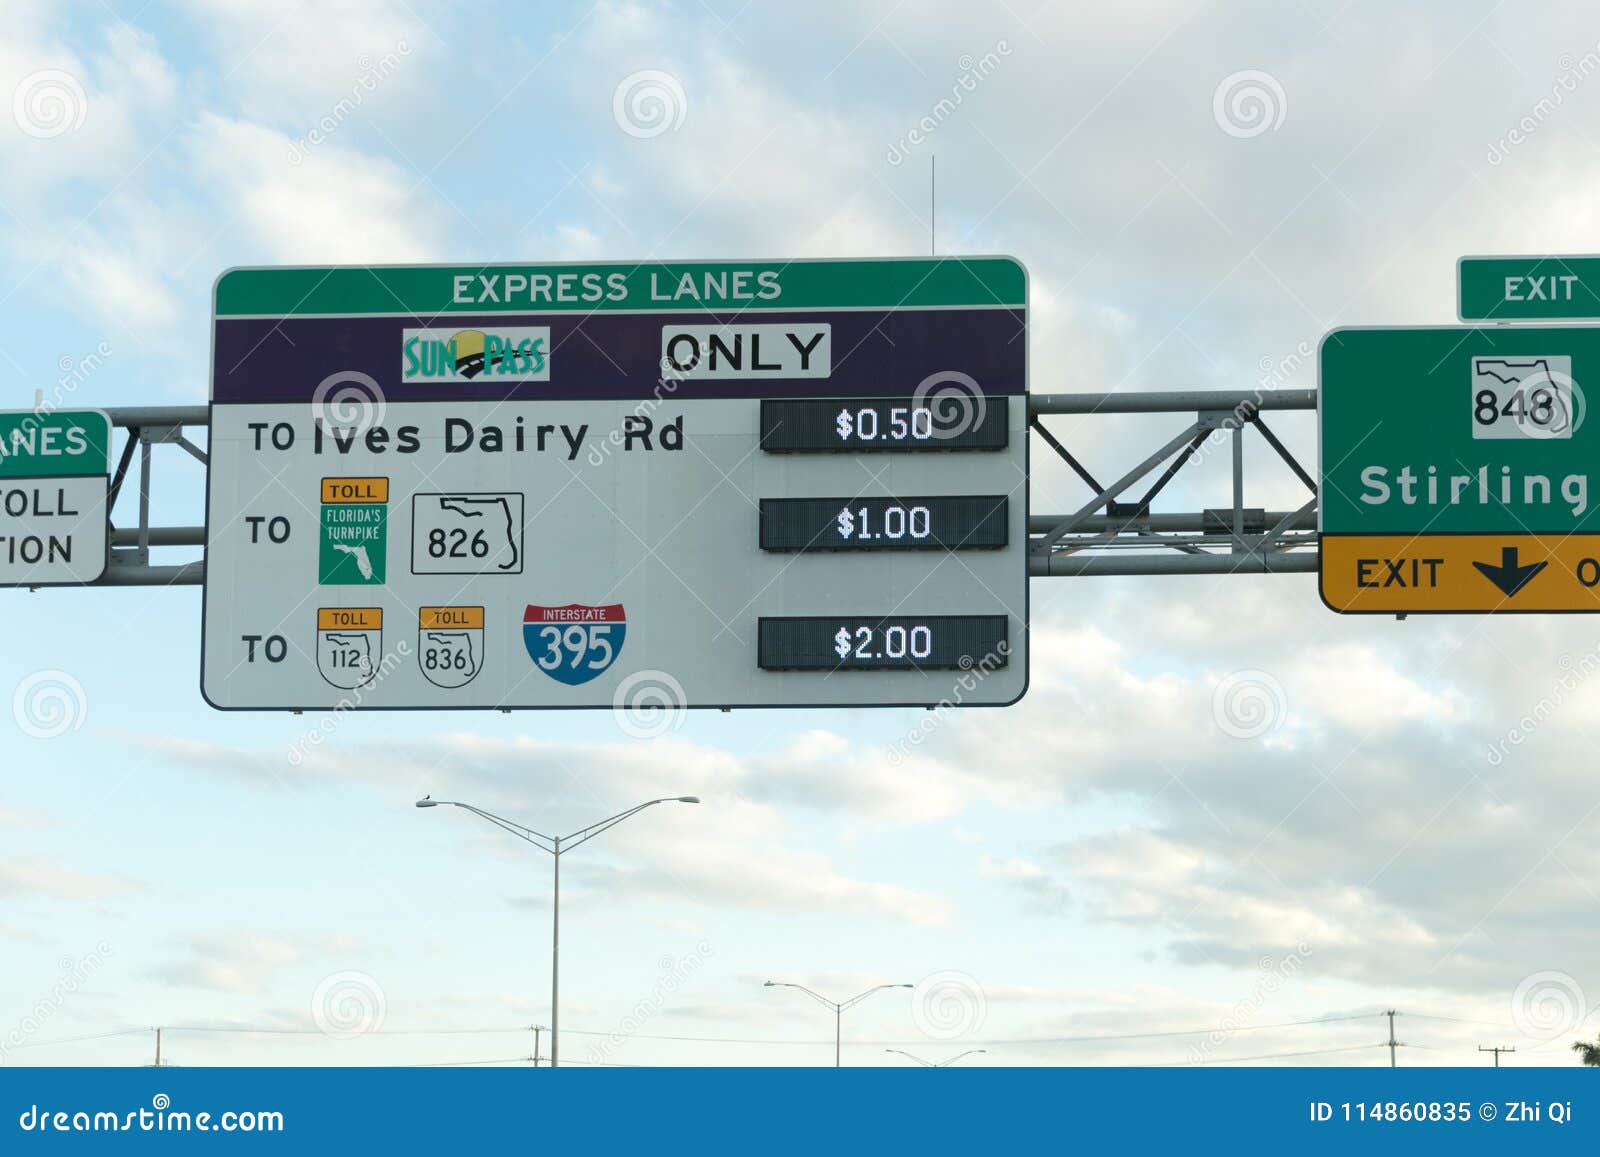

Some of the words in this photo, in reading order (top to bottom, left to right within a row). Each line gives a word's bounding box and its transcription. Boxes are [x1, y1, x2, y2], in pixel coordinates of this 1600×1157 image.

[453, 273, 628, 303] EXPRESS
[651, 271, 781, 300] LANES
[1504, 275, 1579, 301] EXIT
[667, 332, 826, 372] ONLY
[1474, 388, 1553, 426] 848
[248, 422, 295, 451] TO
[314, 417, 421, 454] Ives
[445, 416, 589, 461] Dairy
[624, 415, 685, 452] Rd
[836, 408, 932, 440] $0.50
[0, 488, 78, 518] OLL
[329, 484, 378, 499] TOLL
[1359, 465, 1588, 517] Stirling
[245, 516, 291, 544] TO
[327, 509, 381, 523] FLORIDA'S
[837, 507, 931, 539] $1.00
[327, 527, 380, 541] TURNPIKE
[428, 528, 489, 558] 826
[0, 535, 72, 564] ION
[1357, 559, 1444, 588] EXIT
[332, 612, 368, 625] TOLL
[434, 611, 470, 624] TOLL
[543, 608, 607, 621] INTERSTATE
[242, 635, 288, 663] TO
[538, 625, 613, 670] 395
[834, 626, 931, 658] $2.00
[331, 649, 361, 668] 112
[425, 649, 467, 670] 836
